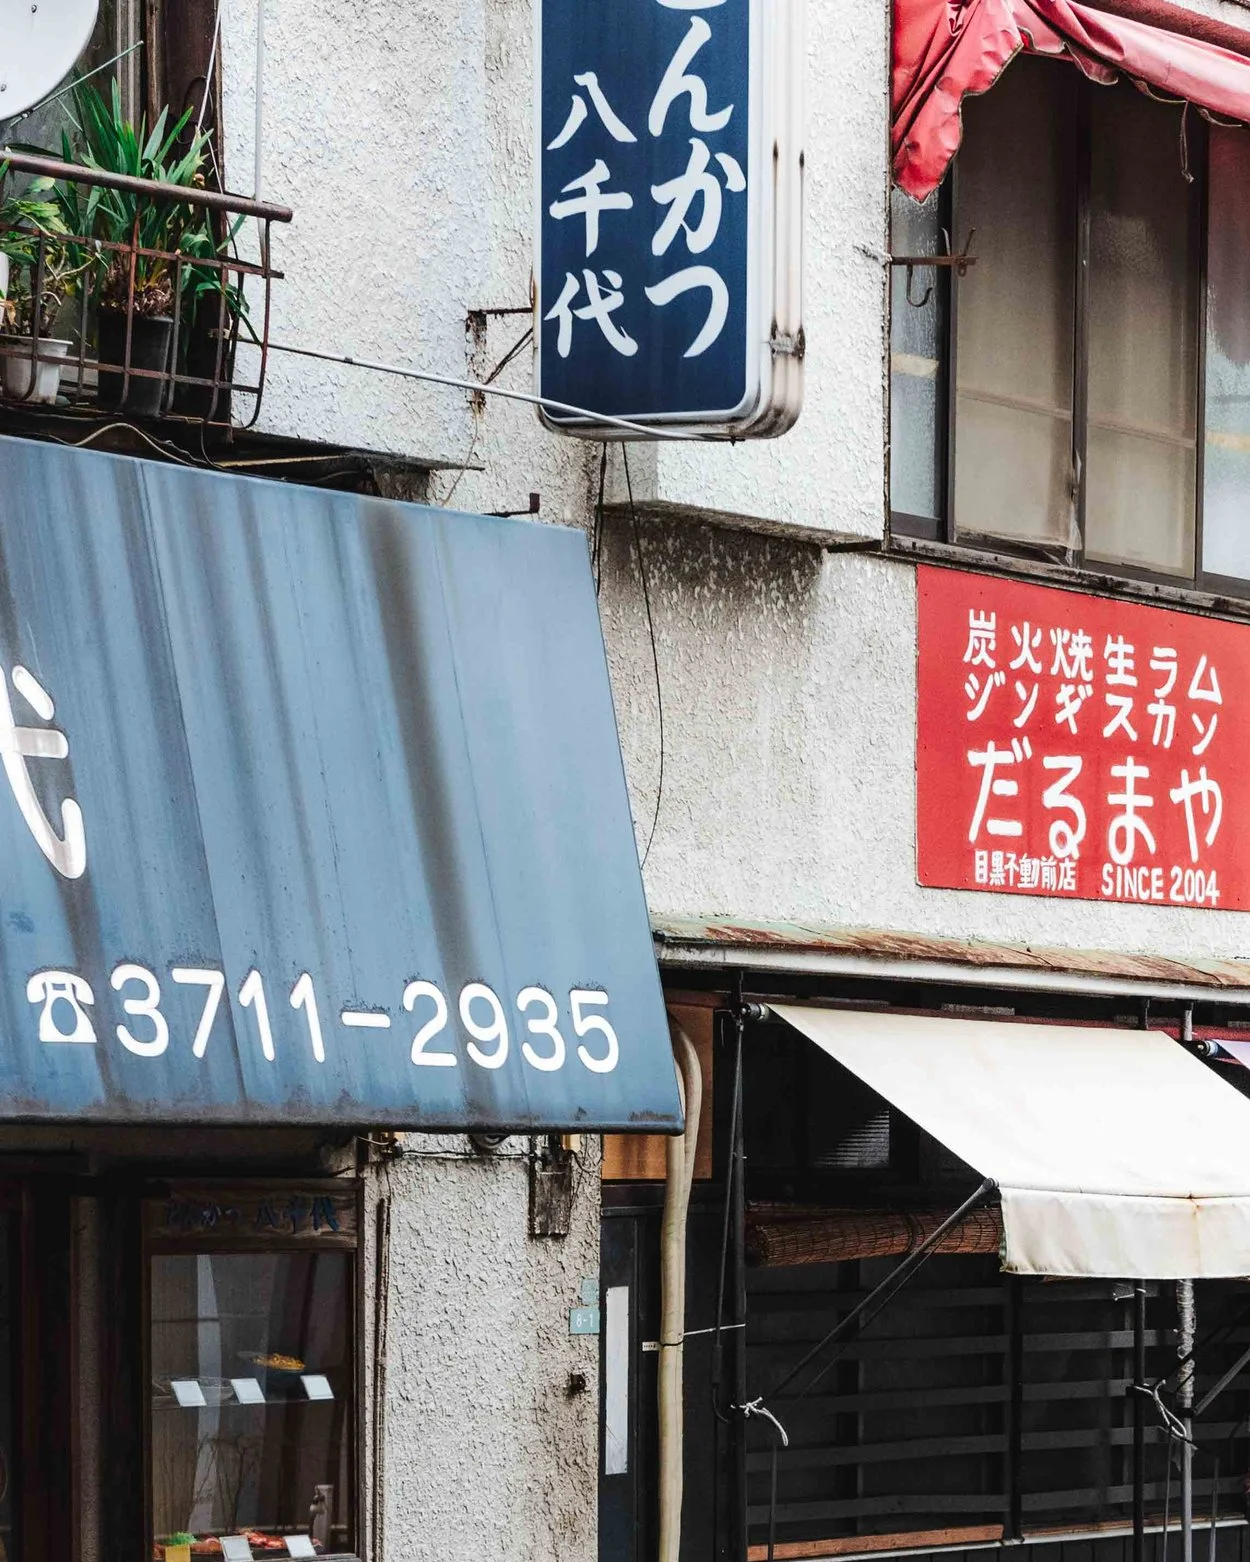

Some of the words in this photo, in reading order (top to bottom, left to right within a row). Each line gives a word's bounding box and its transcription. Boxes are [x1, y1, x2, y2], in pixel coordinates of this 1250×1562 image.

[544, 72, 638, 358] 八千代
[647, 0, 746, 357] んかつ
[963, 608, 1223, 705] 炭火焼生ラム
[962, 671, 1218, 756] ジンギスカン
[966, 736, 1223, 865] だるまや
[974, 850, 1077, 892] 目黒不動前店
[1101, 863, 1164, 900] SINCE
[1170, 866, 1220, 906] 2004
[110, 964, 620, 1073] 3711-2935
[576, 1313, 594, 1328] 8-1
